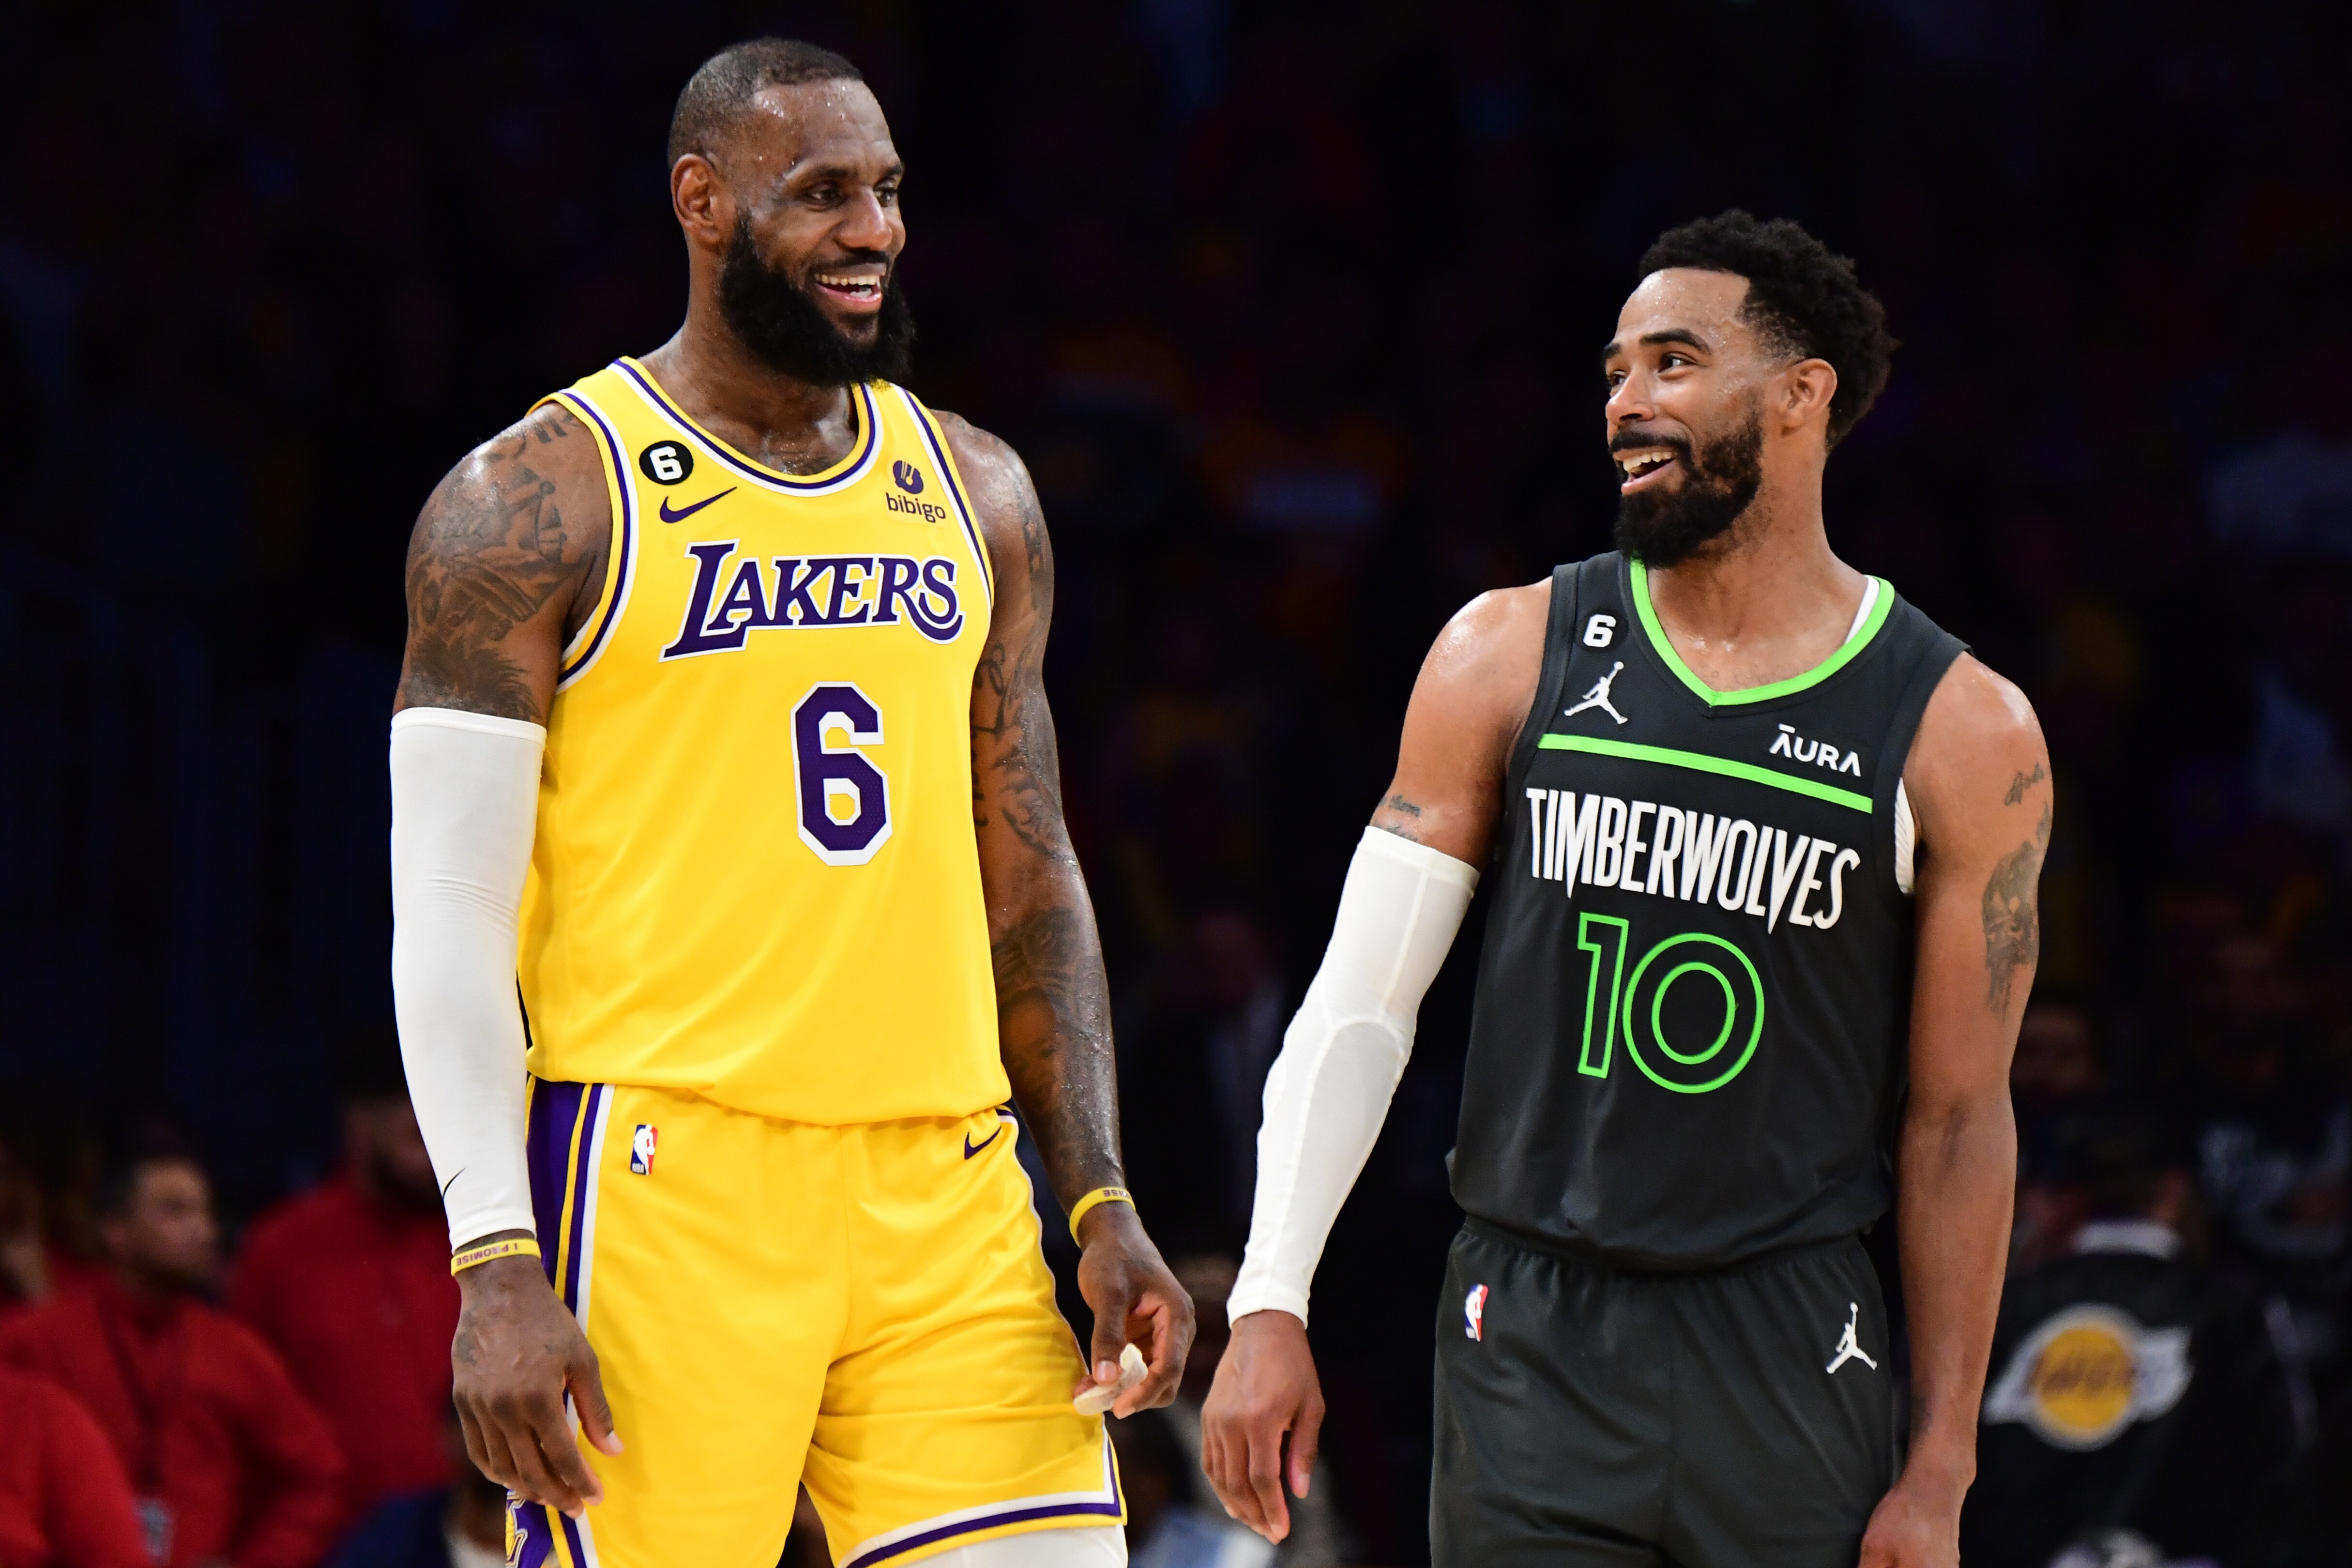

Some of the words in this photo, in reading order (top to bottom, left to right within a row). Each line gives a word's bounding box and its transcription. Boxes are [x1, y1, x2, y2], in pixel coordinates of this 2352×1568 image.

[649, 445, 683, 481] 6
[885, 491, 946, 523] bibigo
[659, 538, 966, 663] LAKERS
[1582, 613, 1617, 648] 6
[789, 681, 893, 866] 6
[1526, 788, 1861, 934] TIMBERWOLVES
[1577, 911, 1765, 1094] 10
[456, 1244, 509, 1266] PROMISE
